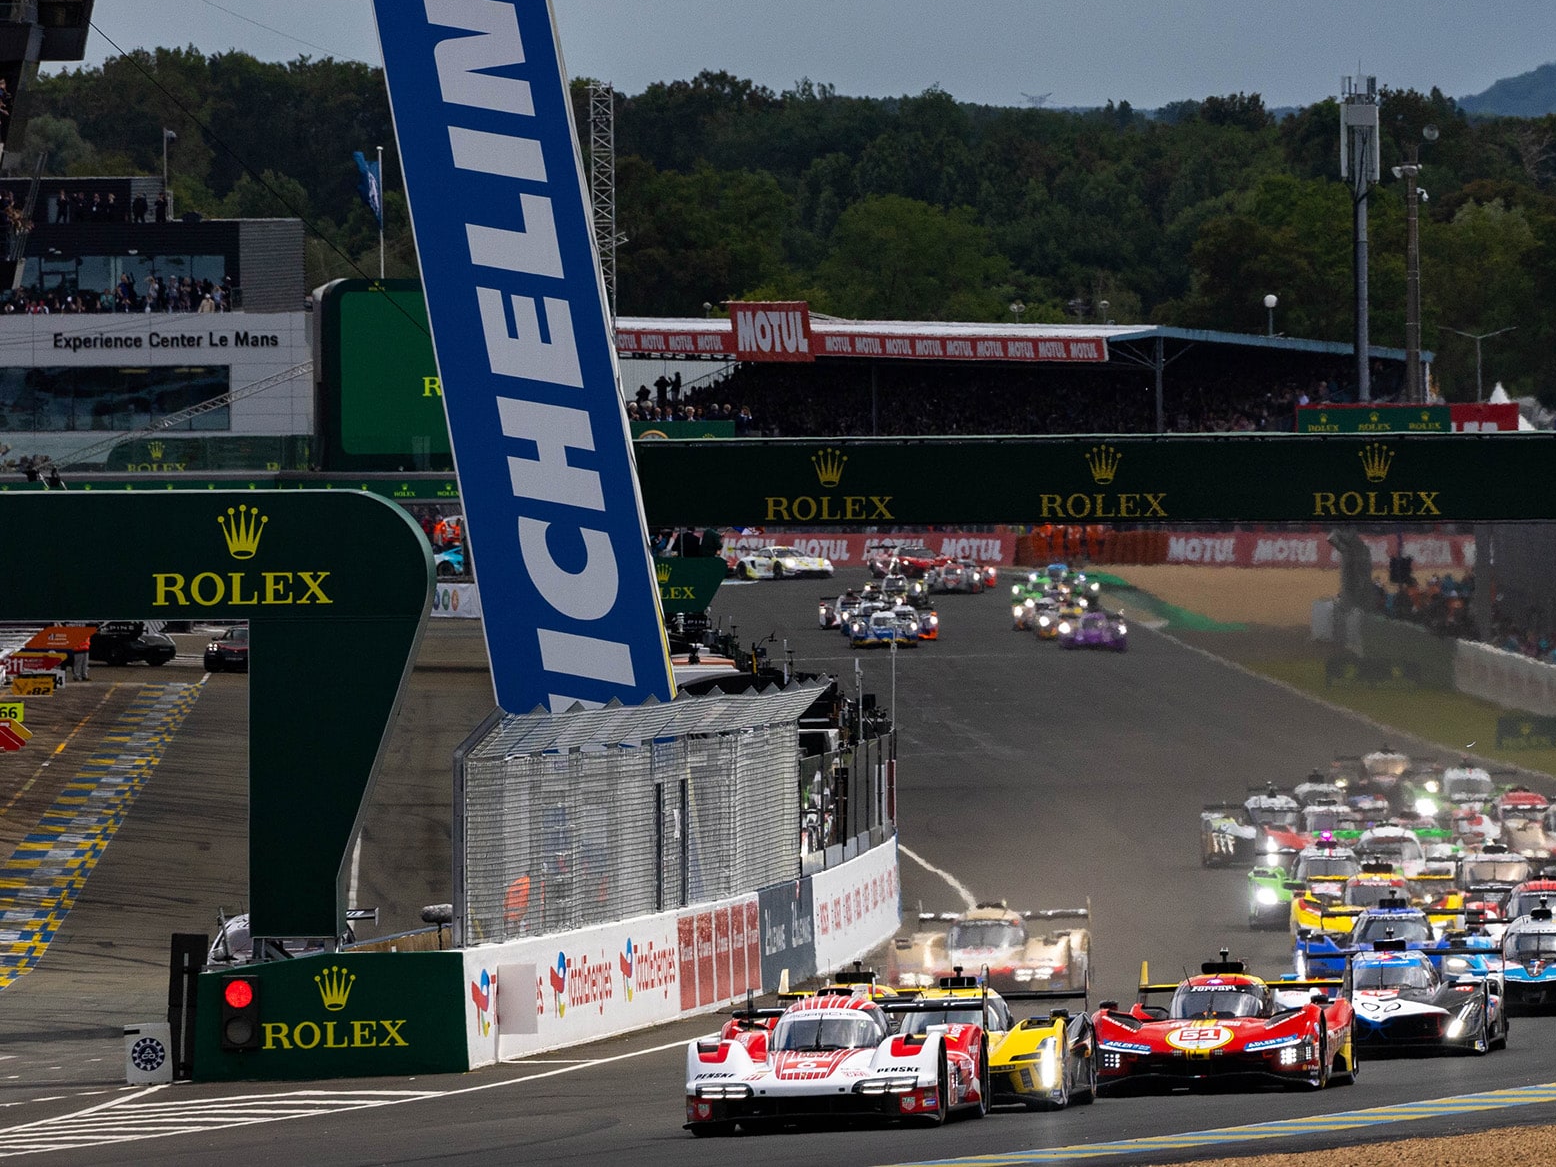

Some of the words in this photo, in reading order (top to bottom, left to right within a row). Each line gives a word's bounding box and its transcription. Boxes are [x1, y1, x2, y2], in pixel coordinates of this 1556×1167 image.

[53, 333, 143, 352] Experience
[149, 332, 203, 348] Center
[209, 331, 229, 347] Le
[234, 331, 279, 347] Mans
[641, 335, 665, 350] MOTUL
[669, 336, 694, 351] MOTUL
[698, 336, 723, 351] MOTUL
[736, 311, 809, 354] MOTUL
[825, 336, 851, 352] MOTUL
[855, 337, 882, 353] MOTUL
[885, 338, 911, 354] MOTUL
[915, 339, 943, 355] MOTUL
[946, 339, 973, 356] MOTUL
[977, 340, 1004, 357] MOTUL
[1008, 341, 1034, 358] MOTUL
[1038, 341, 1066, 358] MOTUL
[1070, 342, 1098, 358] MOTUL
[764, 496, 895, 520] ROLEX
[1039, 493, 1168, 518] ROLEX
[1312, 491, 1442, 516] ROLEX
[794, 539, 849, 561] MOTUL
[940, 537, 1003, 561] MOTUL
[1167, 537, 1236, 562] MOTUL
[152, 571, 334, 606] ROLEX
[660, 586, 696, 600] LEX
[566, 948, 613, 1015] TotalEnergies
[633, 934, 677, 999] TotalEnergies
[1189, 985, 1237, 993] Ferrari
[262, 1020, 409, 1049] ROLEX
[1180, 1029, 1219, 1040] 51
[1248, 1039, 1277, 1048] ADLER
[694, 1072, 736, 1081] PENSKE
